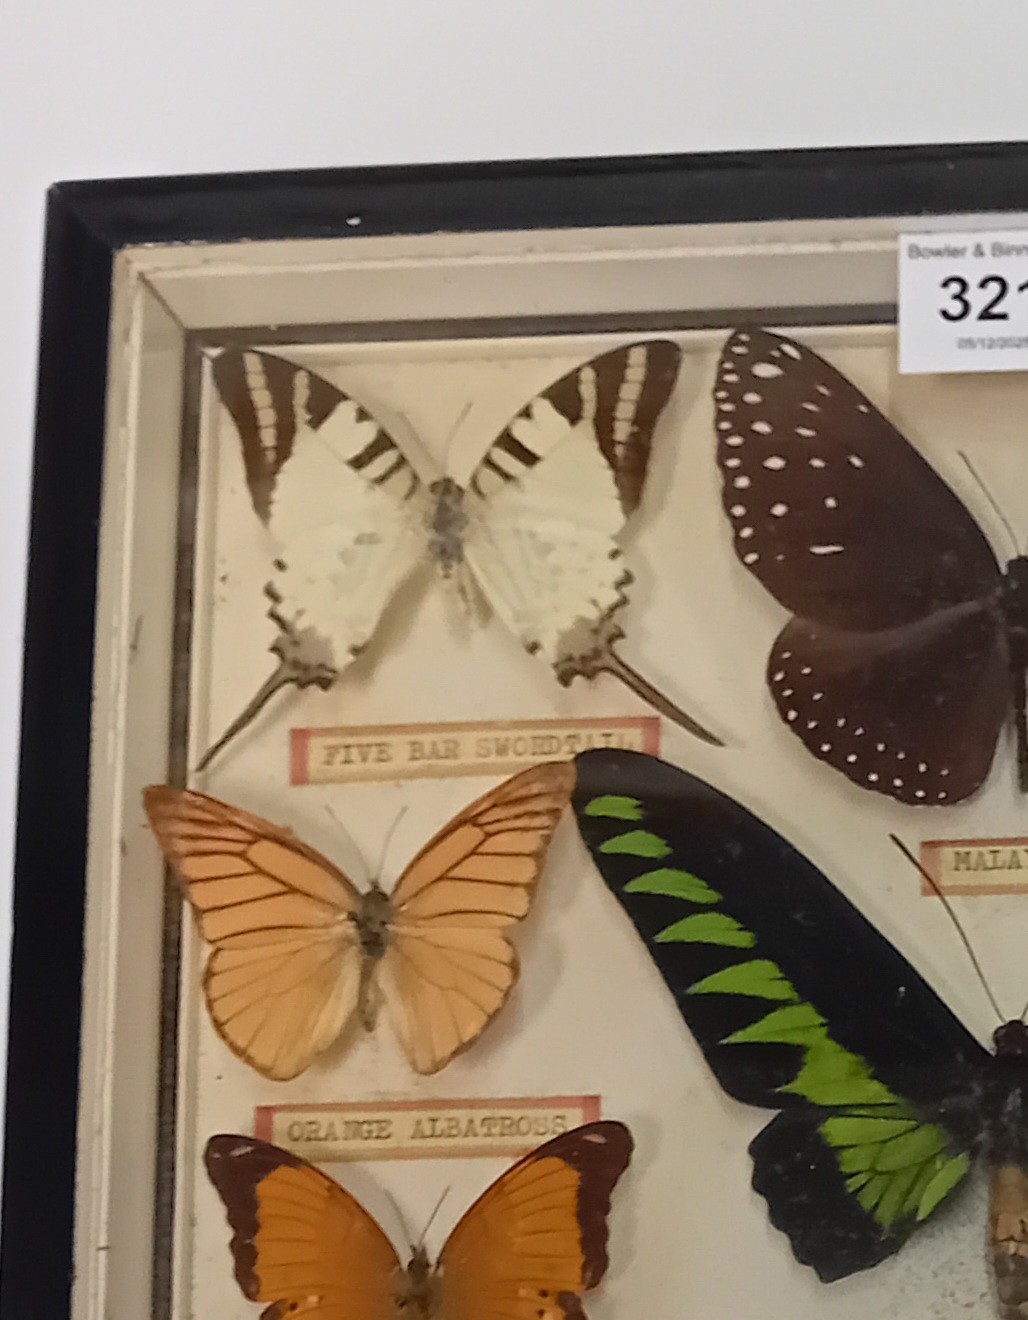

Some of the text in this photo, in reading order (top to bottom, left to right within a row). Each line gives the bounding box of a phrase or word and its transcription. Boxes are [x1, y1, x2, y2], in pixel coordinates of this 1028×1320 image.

[908, 244, 967, 260] Bowler
[973, 243, 985, 258] &
[322, 742, 392, 767] FIVE
[408, 738, 461, 762] BAR
[286, 1114, 568, 1143] ORANGE ALBATROSS
